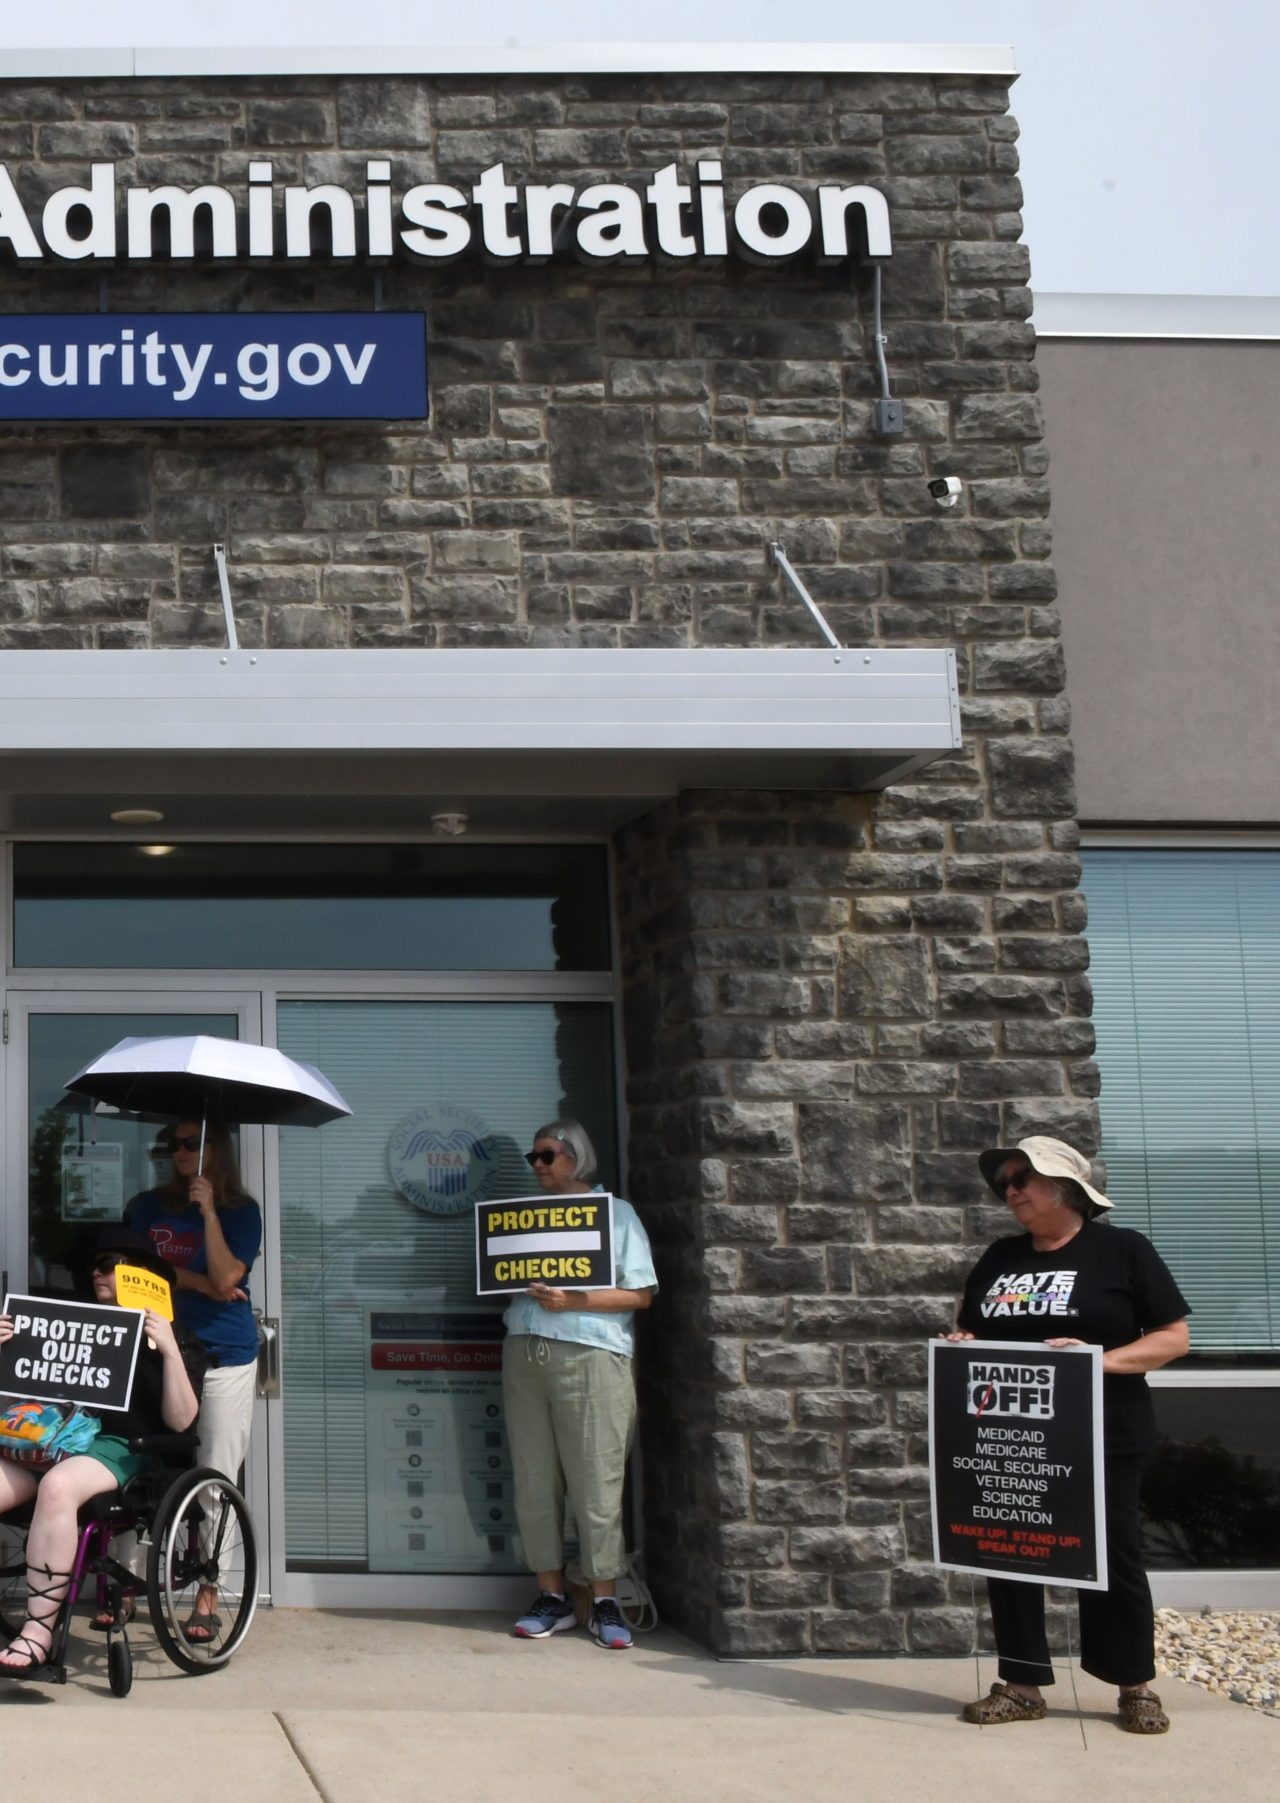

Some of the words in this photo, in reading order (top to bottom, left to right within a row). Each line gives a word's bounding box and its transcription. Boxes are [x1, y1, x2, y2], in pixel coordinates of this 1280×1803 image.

[394, 1109, 432, 1150] SOCIAL
[427, 1153, 464, 1167] USA
[394, 1167, 497, 1211] ADMINISTRATION
[488, 1206, 598, 1232] PROTECT
[495, 1257, 592, 1281] CHECKS
[122, 1274, 140, 1284] 90
[143, 1278, 167, 1296] YRS
[992, 1271, 1078, 1288] HATE
[983, 1292, 1071, 1303] AMERICAN
[986, 1287, 1002, 1296] IS
[1004, 1285, 1042, 1294] NOT
[1046, 1285, 1073, 1293] AN
[14, 1314, 128, 1347] PROTECT
[42, 1340, 93, 1365] OUR
[387, 1352, 416, 1362] Save
[418, 1352, 450, 1363] Time,
[454, 1353, 471, 1363] Go
[15, 1357, 112, 1389] CHECKS
[972, 1366, 1050, 1385] HANDS
[972, 1384, 1050, 1415] OFF!
[977, 1427, 1045, 1443] MEDICAID
[975, 1443, 1047, 1460] MEDICARE
[953, 1456, 1001, 1472] SOCIAL
[1003, 1461, 1072, 1478] SECURITY
[975, 1474, 1048, 1492] VETERANS
[982, 1490, 1041, 1508] SCIENCE
[972, 1505, 1053, 1525] EDUCATION
[951, 1524, 985, 1537] WAKE
[987, 1528, 1008, 1539] UP!
[1012, 1530, 1056, 1545] STAND
[1059, 1535, 1081, 1548] UP!
[978, 1541, 1017, 1554] SPEAK
[1020, 1544, 1050, 1558] OUT!
